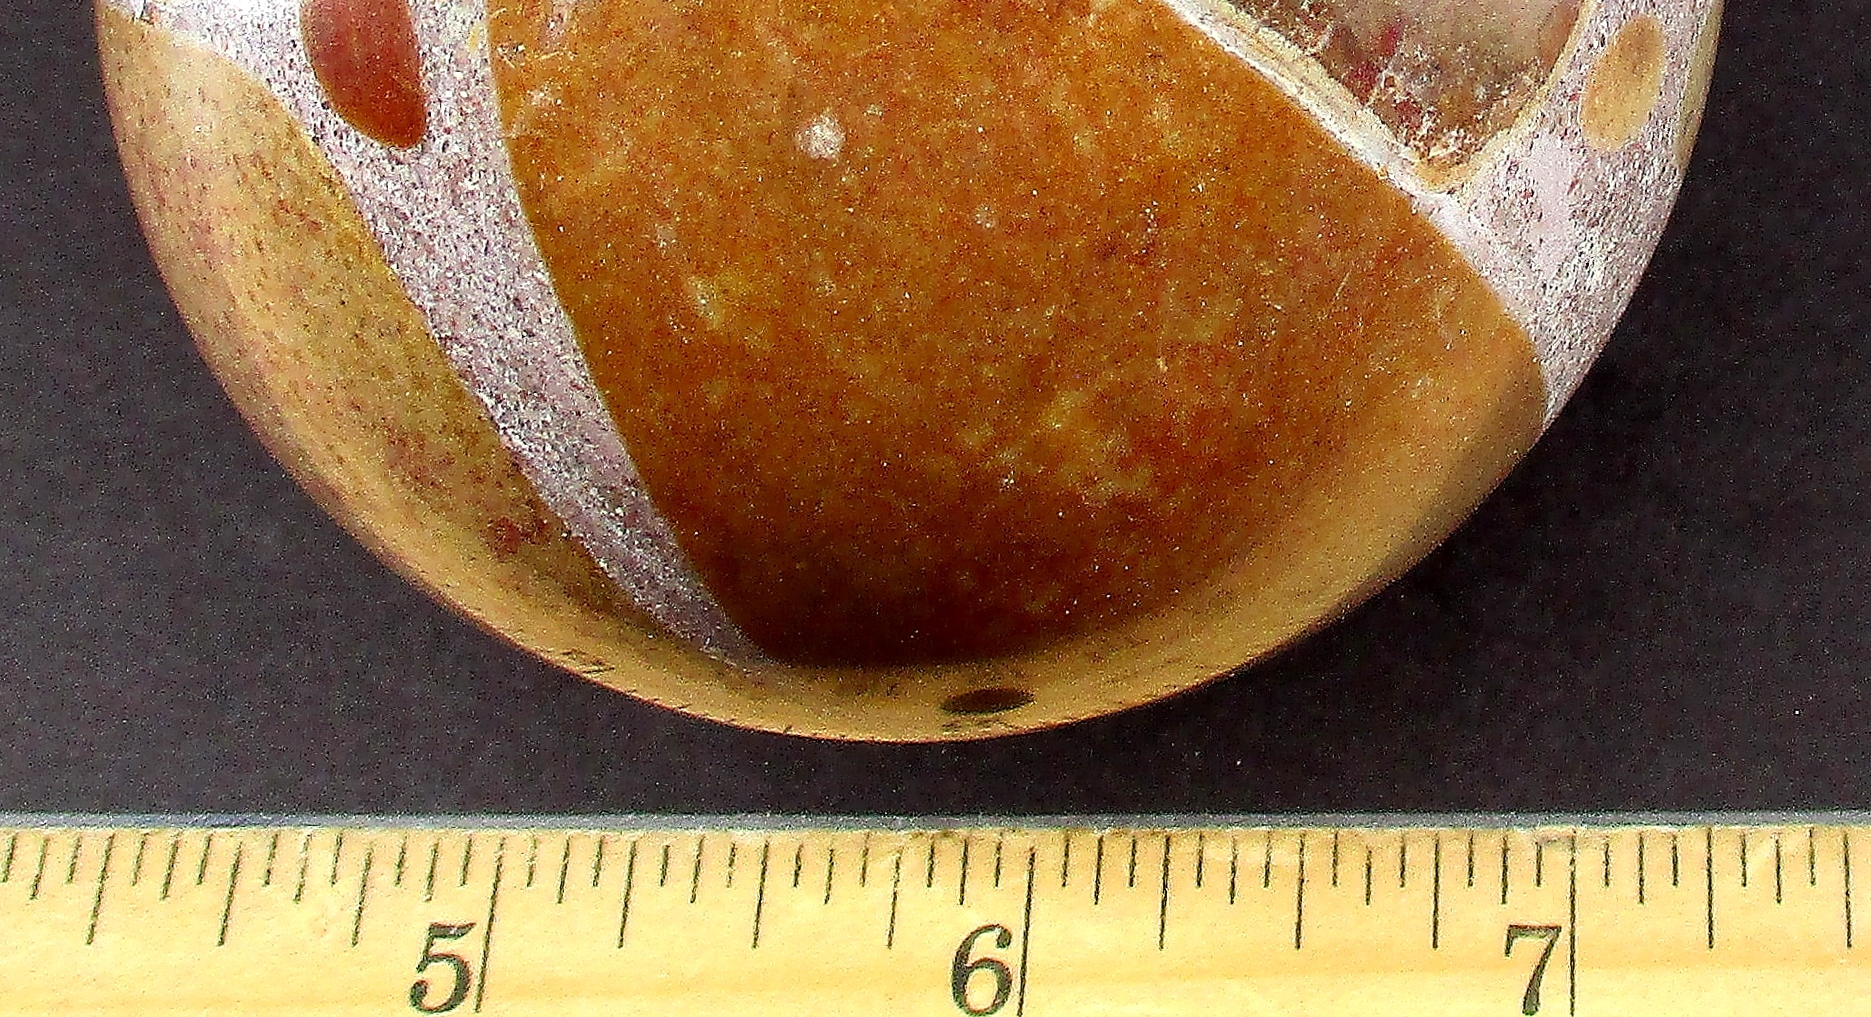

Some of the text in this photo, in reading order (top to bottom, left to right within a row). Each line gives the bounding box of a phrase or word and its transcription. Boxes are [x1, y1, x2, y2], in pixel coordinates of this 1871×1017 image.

[409, 922, 1562, 1016] 5 6 7
